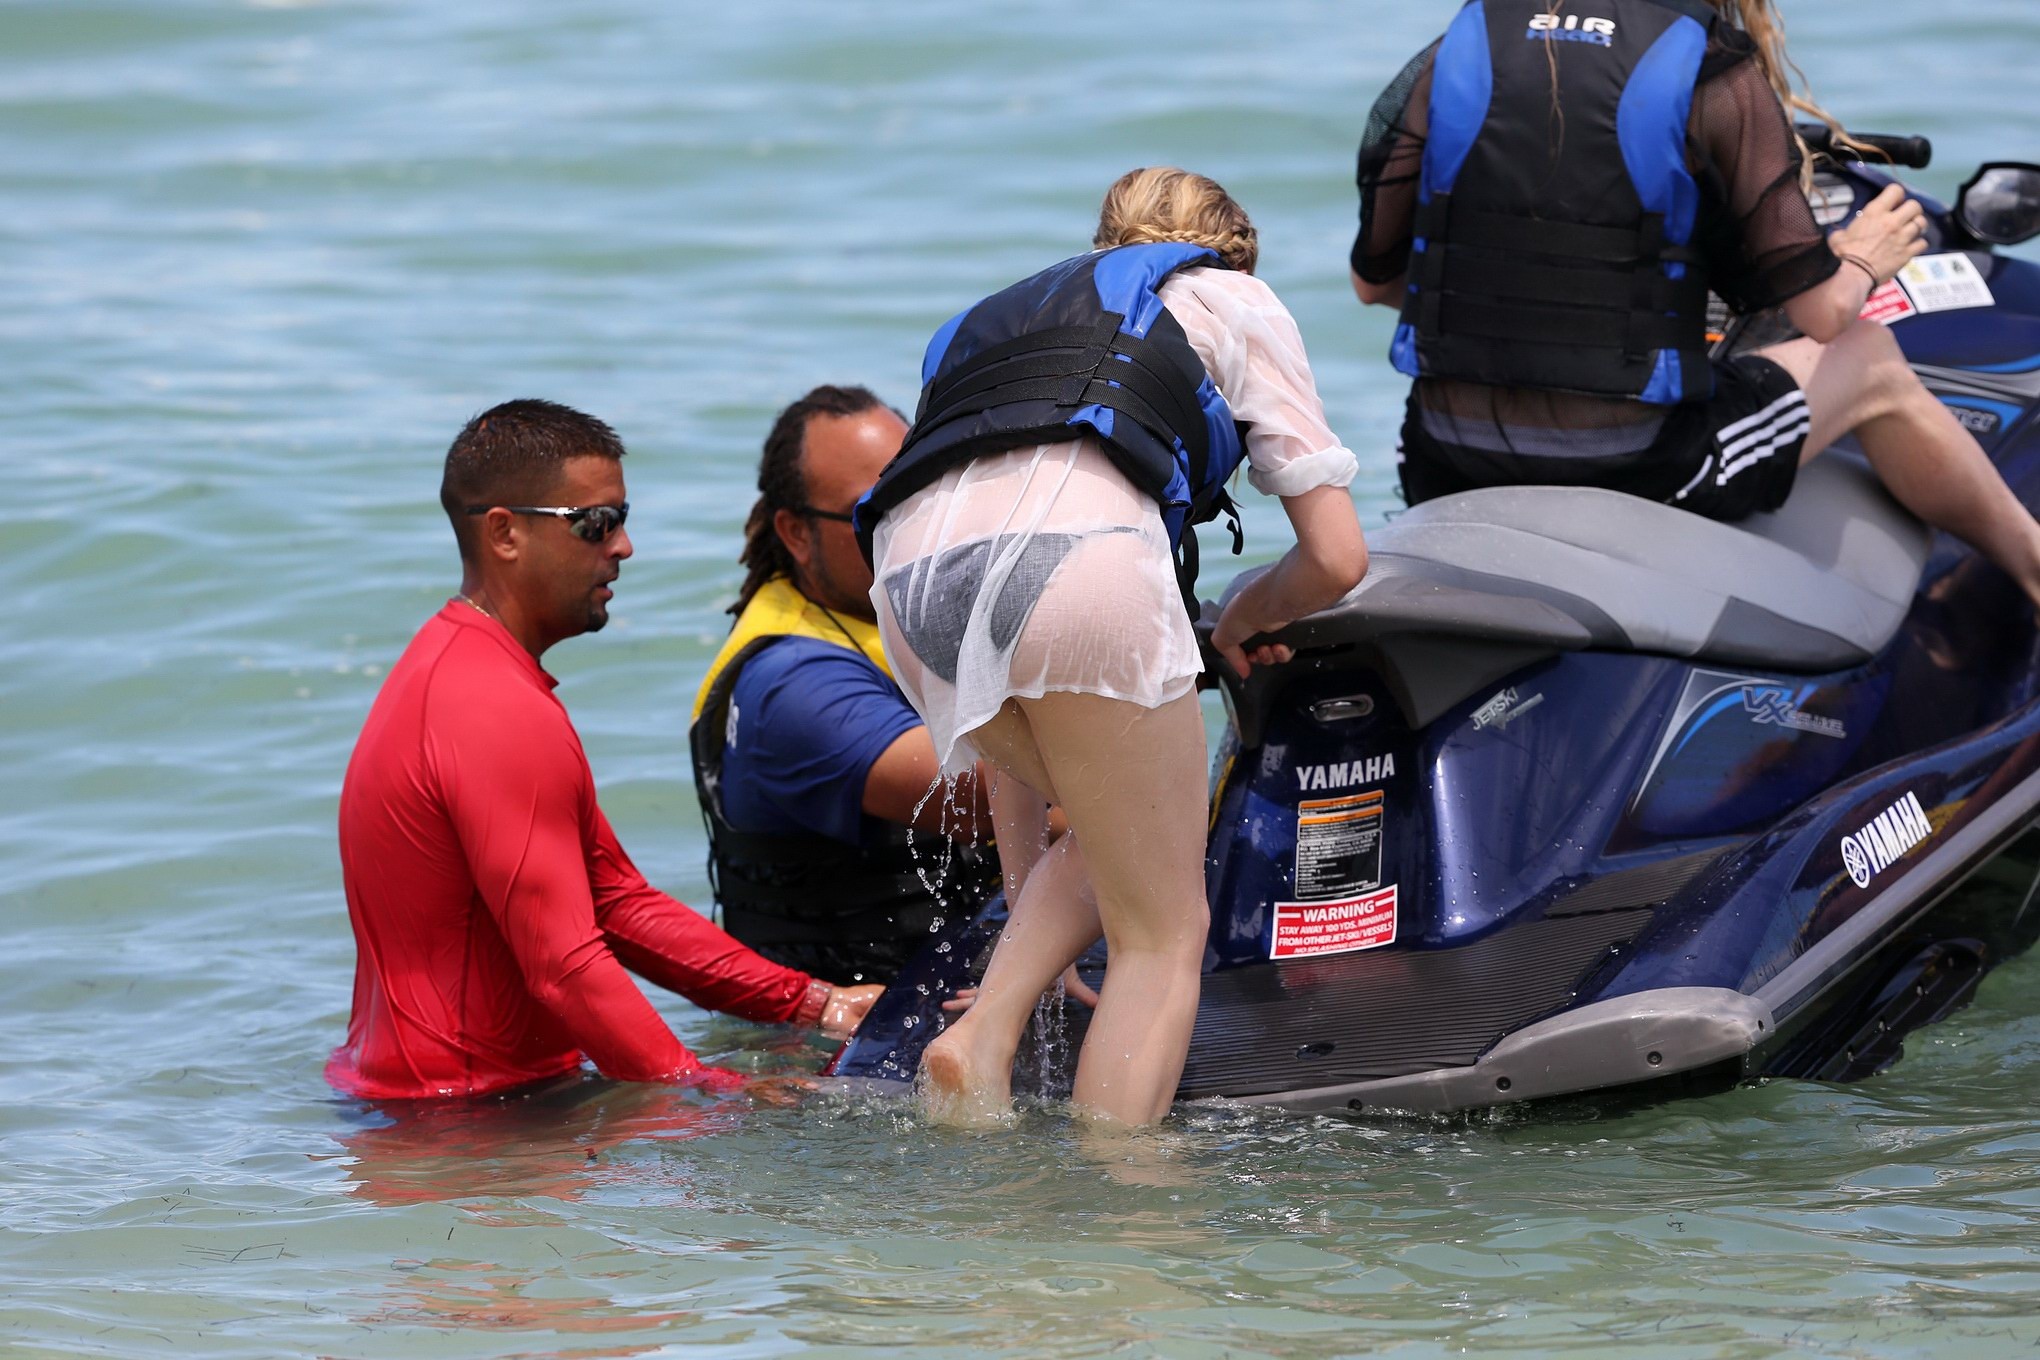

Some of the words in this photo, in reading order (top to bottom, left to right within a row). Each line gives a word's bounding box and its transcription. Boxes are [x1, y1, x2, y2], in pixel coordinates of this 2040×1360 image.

[1296, 753, 1395, 790] YAMAHA
[1855, 791, 1932, 874] YAMAHA
[1279, 925, 1300, 936] STAY
[1300, 924, 1324, 934] AWAY
[1325, 924, 1340, 934] 100
[1358, 911, 1393, 925] MINIMUM
[1303, 900, 1375, 922] WARNING
[1278, 936, 1303, 947] FROM
[1304, 935, 1331, 945] OTHER
